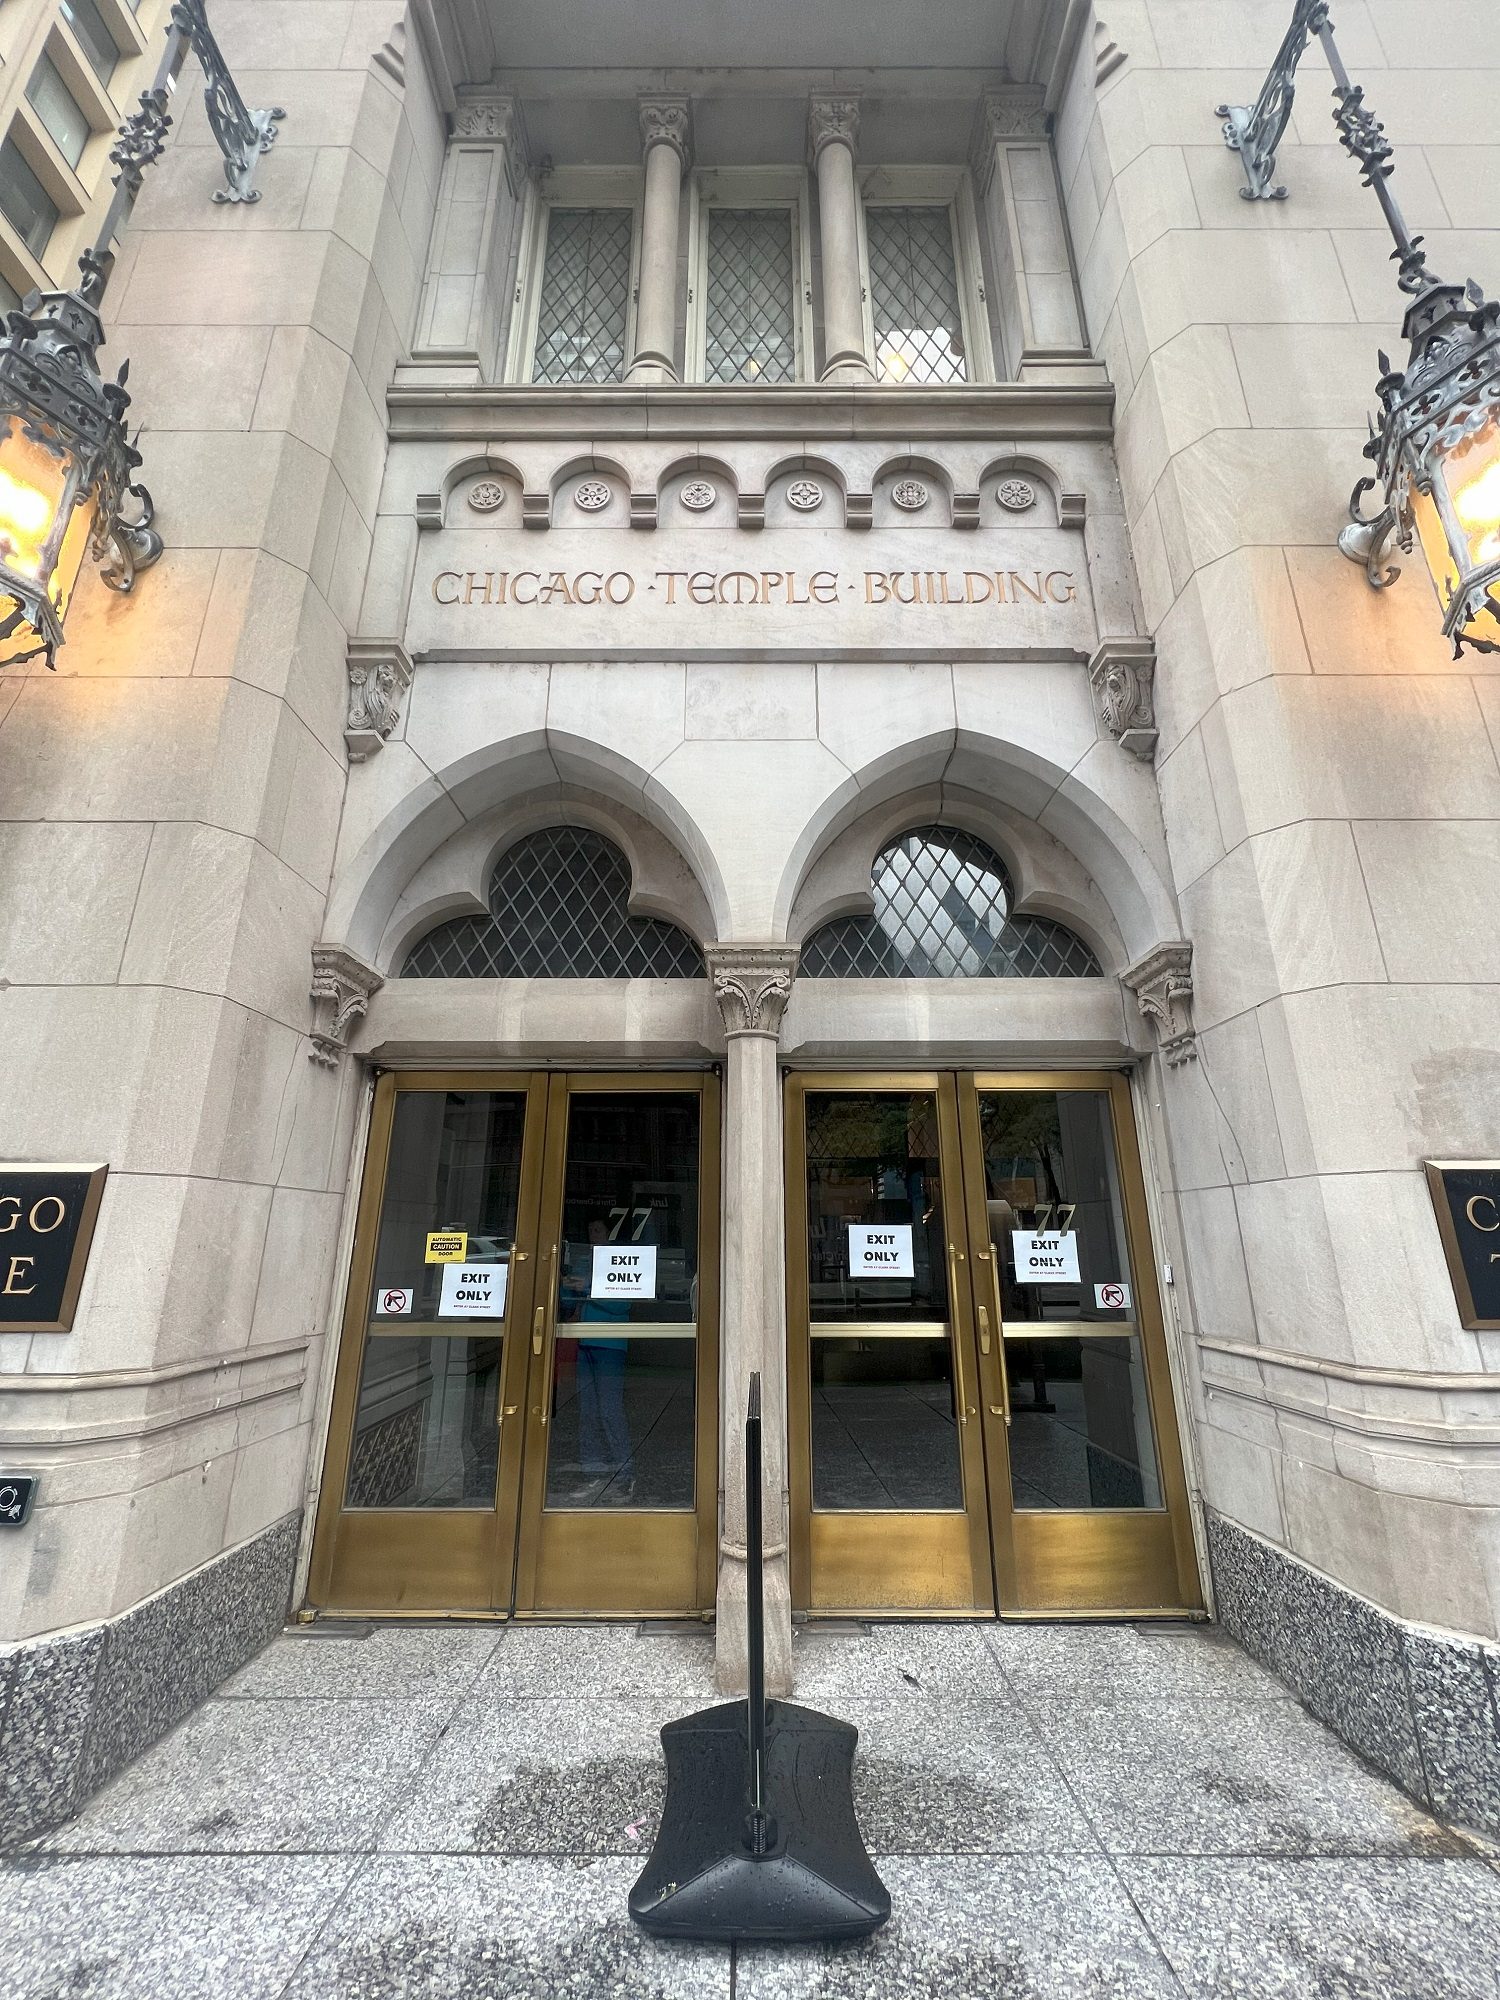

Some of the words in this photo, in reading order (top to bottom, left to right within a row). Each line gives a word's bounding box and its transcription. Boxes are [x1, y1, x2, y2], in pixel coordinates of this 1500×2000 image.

[431, 571, 636, 605] CHICAGO
[655, 571, 840, 605] TEMPLE
[863, 571, 1077, 605] BUILDING
[608, 1207, 653, 1241] 77
[1033, 1203, 1077, 1237] 77
[867, 1234, 896, 1245] EXIT
[1031, 1240, 1060, 1250] EXIT
[611, 1255, 640, 1266] EXIT
[863, 1251, 899, 1262] ONLY
[1028, 1256, 1065, 1267] ONLY
[1, 1256, 39, 1295] E
[460, 1273, 491, 1284] EXIT
[606, 1272, 643, 1283] ONLY
[455, 1290, 492, 1301] ONLY
